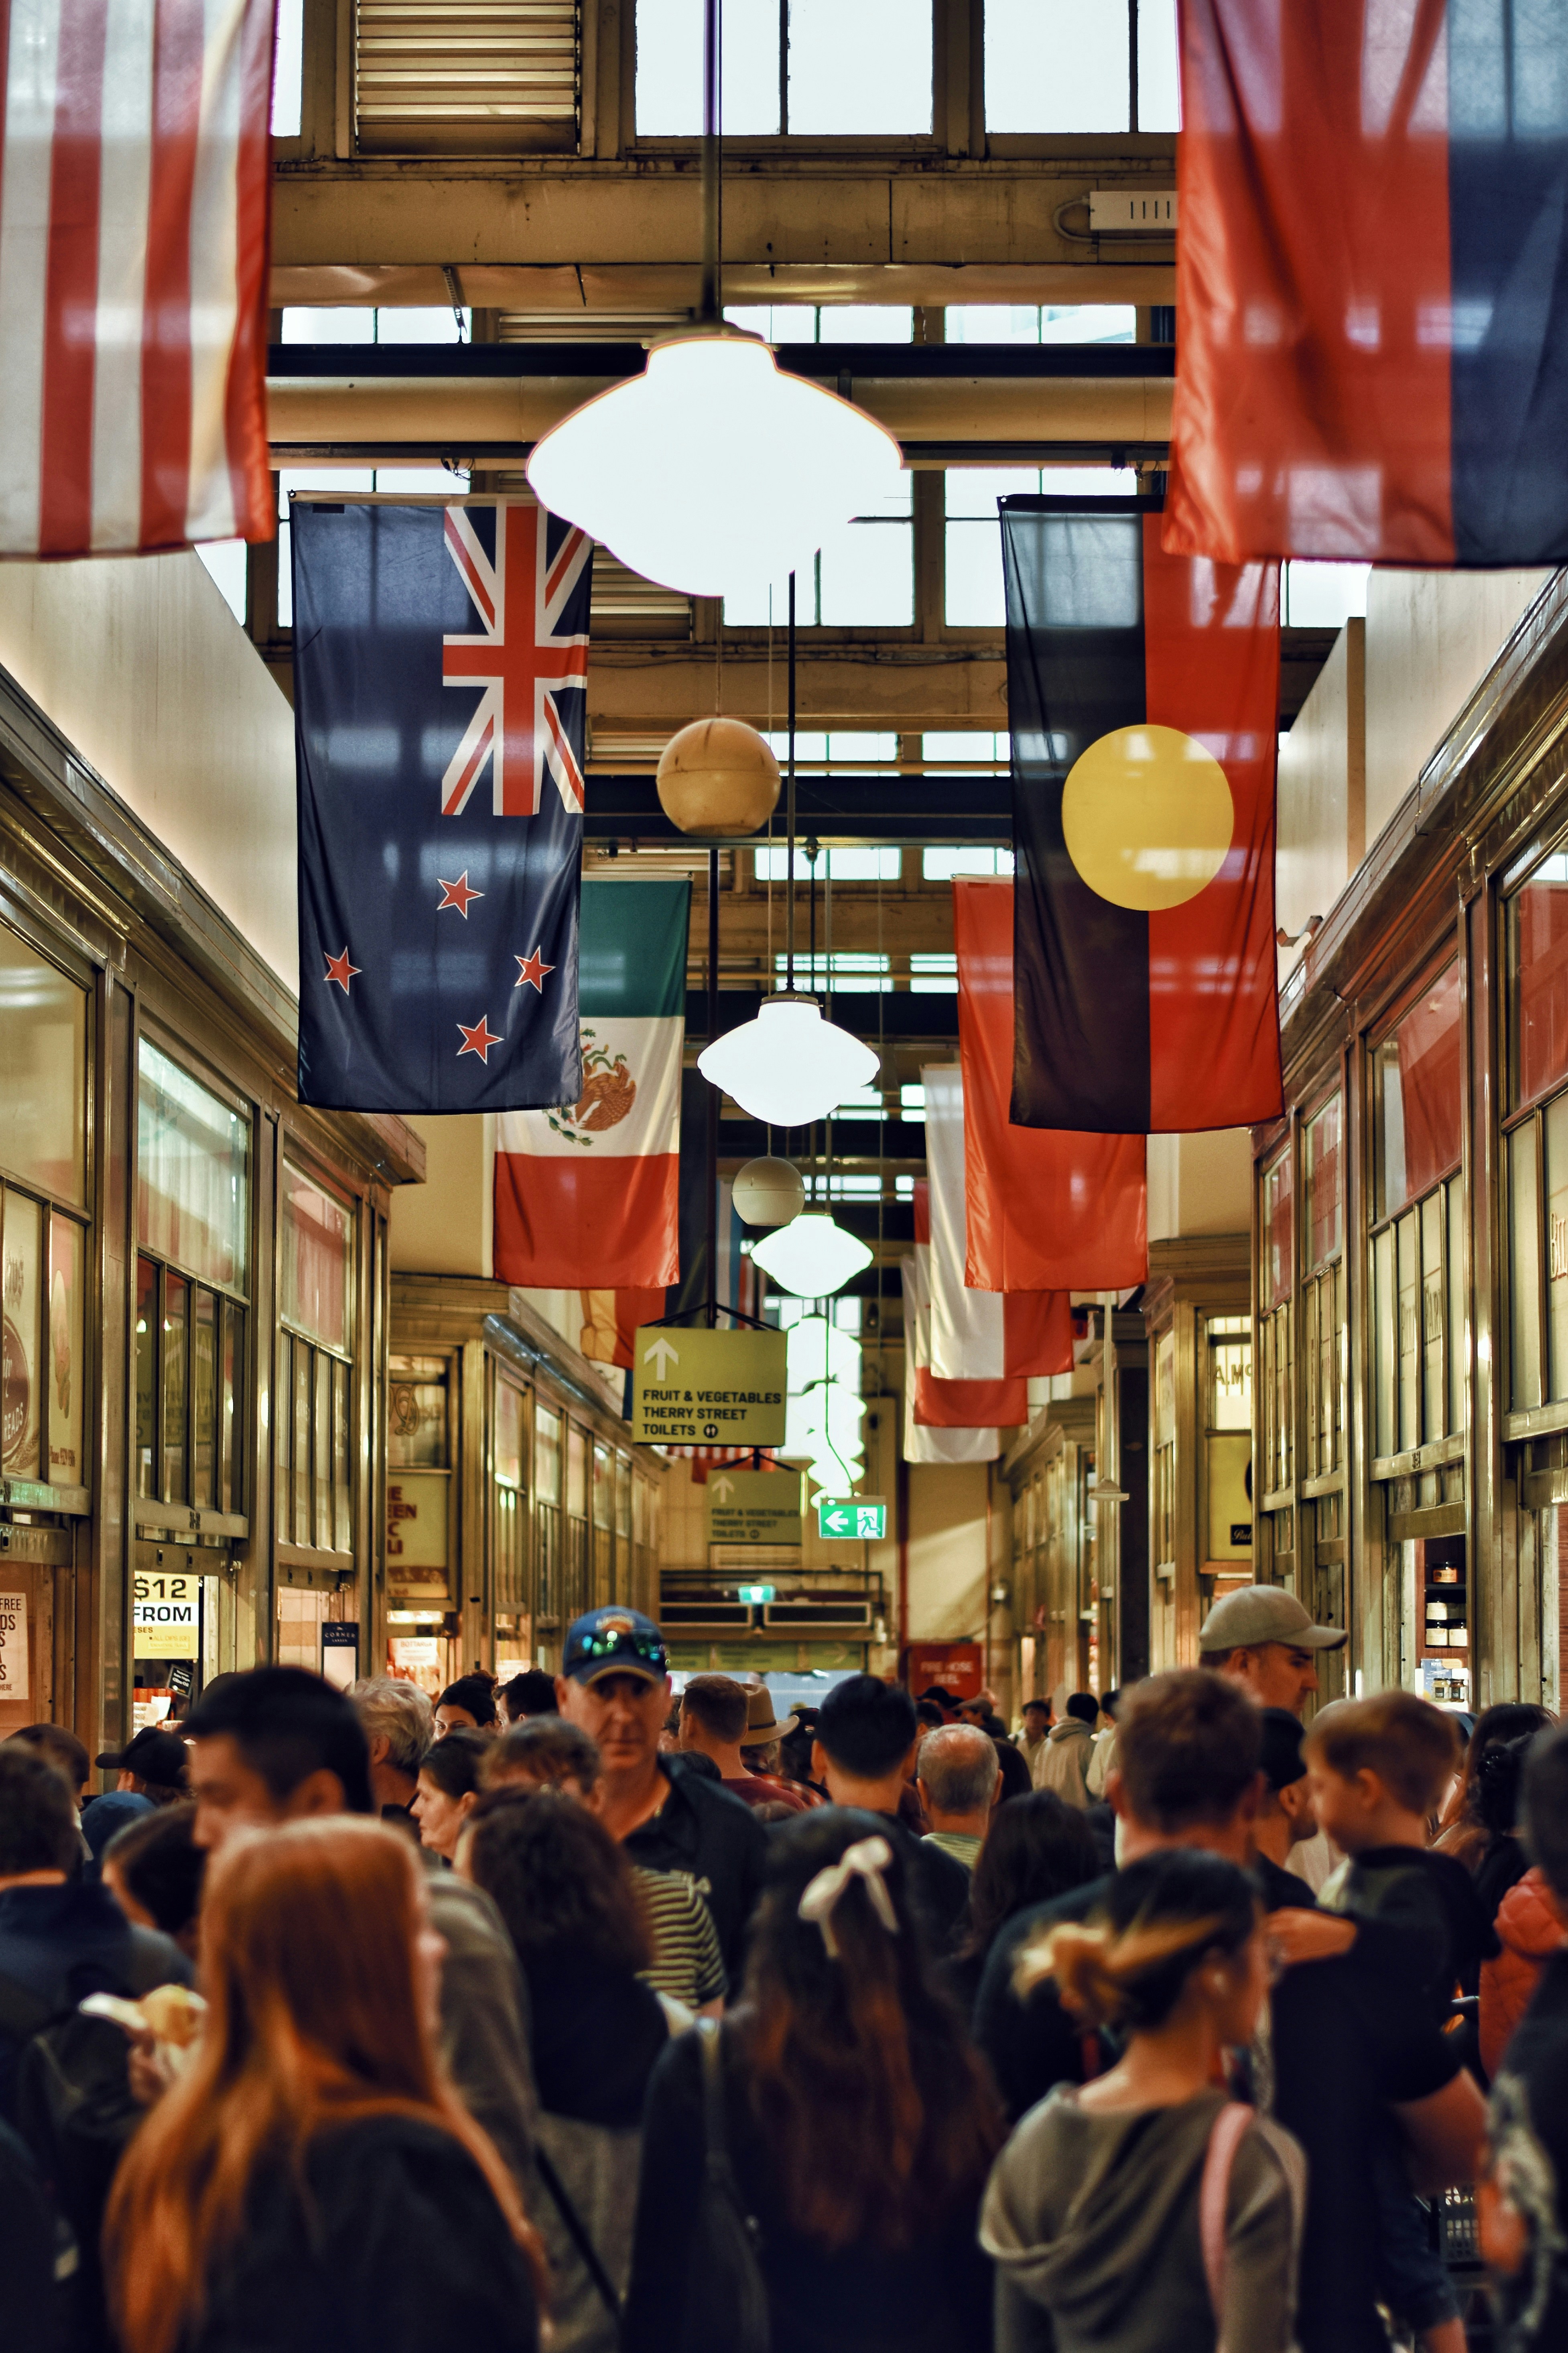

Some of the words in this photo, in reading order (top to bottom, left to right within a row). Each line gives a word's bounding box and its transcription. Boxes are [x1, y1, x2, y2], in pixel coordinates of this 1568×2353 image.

[643, 1390, 680, 1401] FRUIT
[684, 1391, 692, 1401] &
[697, 1391, 781, 1404] VEGETABLES
[643, 1407, 693, 1418] THERRY
[697, 1409, 747, 1420] STREET
[643, 1424, 695, 1435] TOILETS
[134, 1576, 187, 1601] $12
